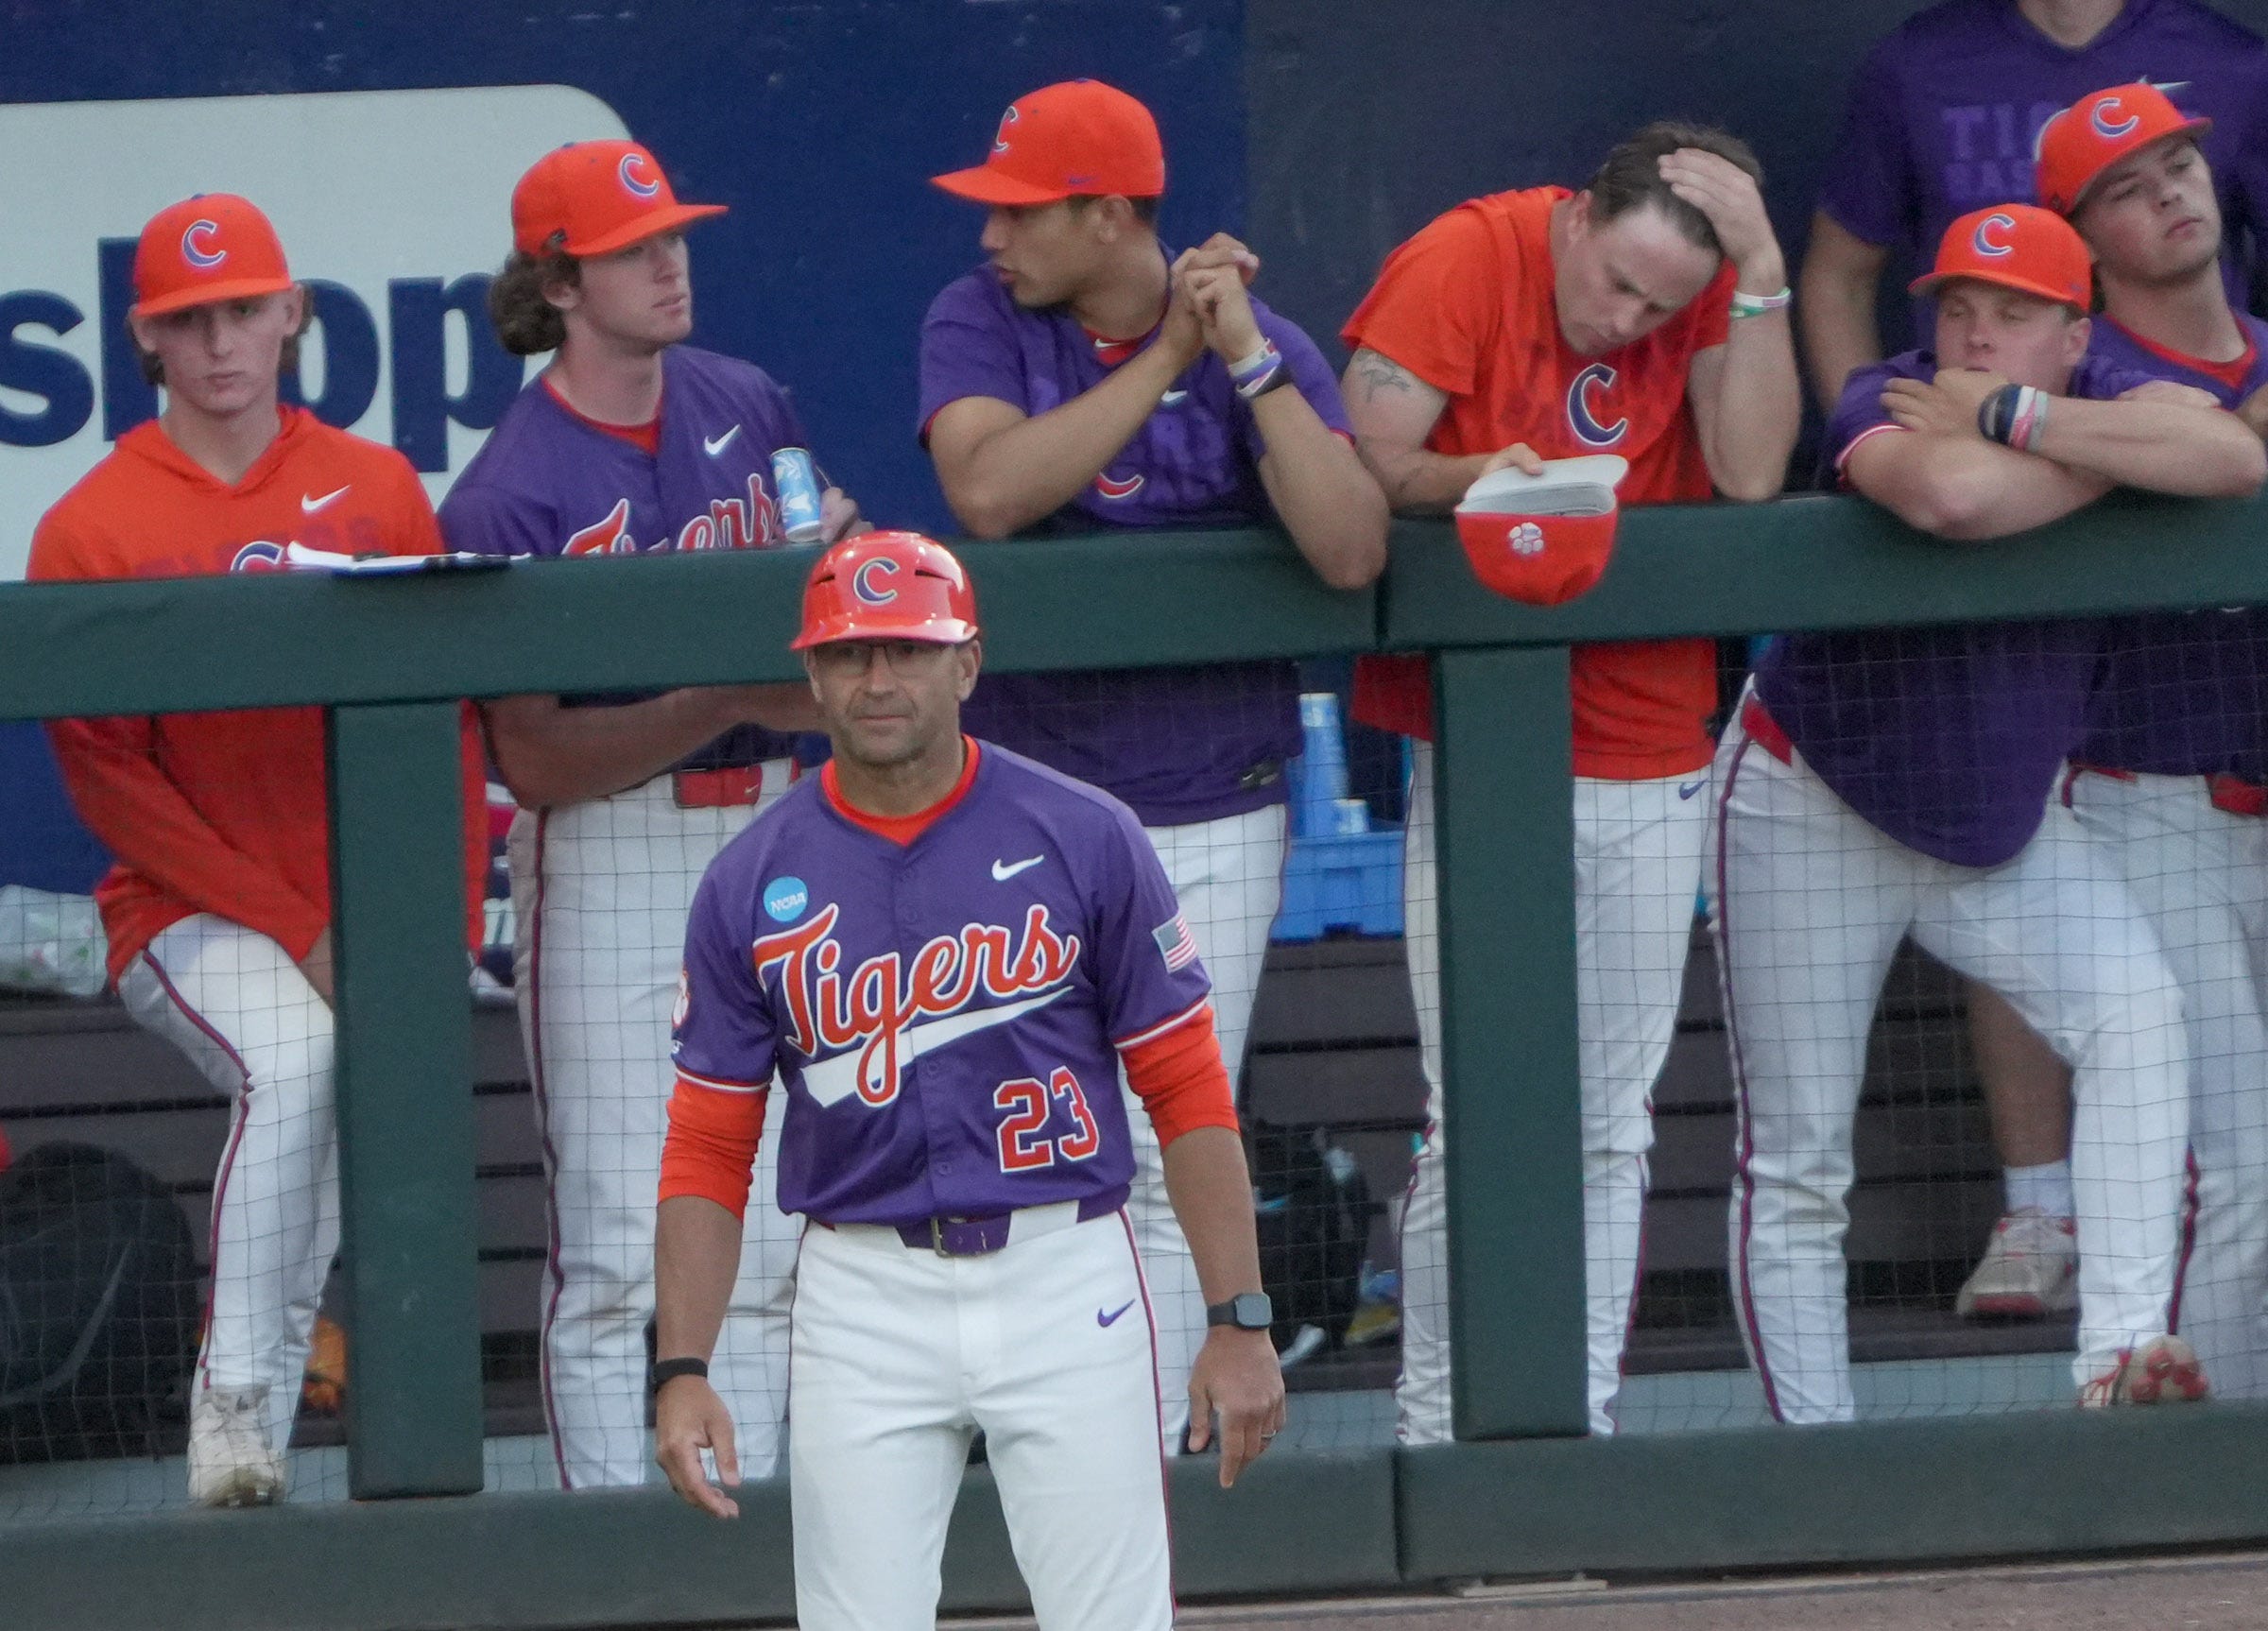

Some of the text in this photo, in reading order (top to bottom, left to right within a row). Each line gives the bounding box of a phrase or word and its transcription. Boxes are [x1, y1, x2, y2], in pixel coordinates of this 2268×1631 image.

[2091, 96, 2139, 138] C
[619, 152, 660, 197] C
[181, 218, 227, 266] C
[1973, 213, 2016, 256] C
[1567, 362, 1628, 446] C
[852, 556, 901, 606] C
[770, 891, 806, 915] NCAA
[752, 902, 1081, 1107] Tigers
[993, 1065, 1100, 1173] 23
